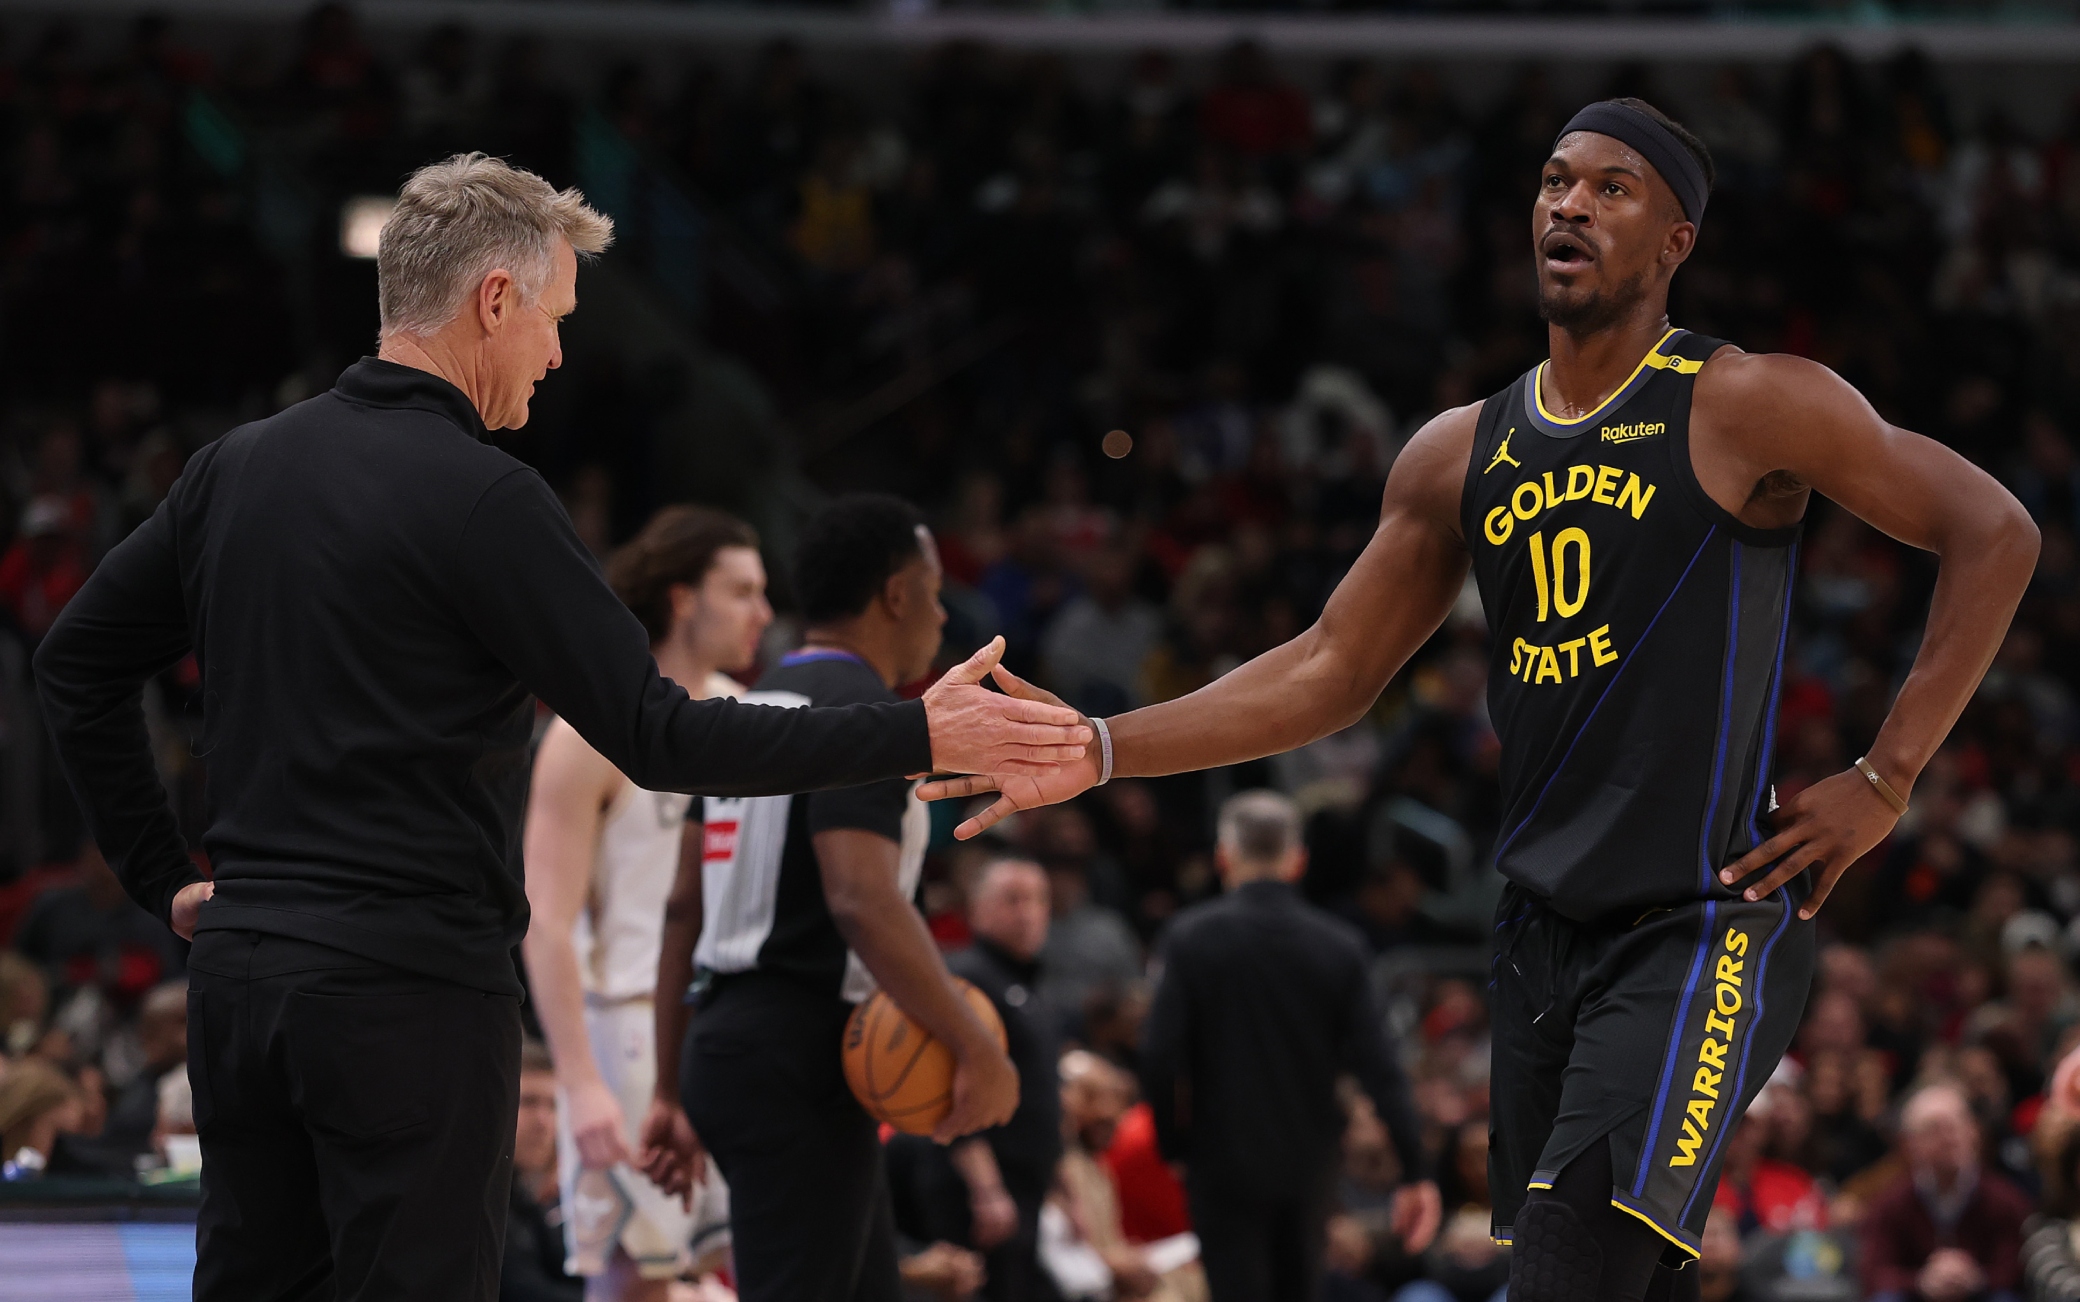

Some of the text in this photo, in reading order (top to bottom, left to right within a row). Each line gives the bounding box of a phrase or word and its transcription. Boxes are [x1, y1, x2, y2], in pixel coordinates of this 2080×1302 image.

[1601, 422, 1665, 442] Rakuten
[1484, 464, 1657, 546] GOLDEN
[1529, 527, 1591, 622] 10
[1509, 623, 1619, 685] STATE
[1669, 928, 1749, 1168] WARRIORS
